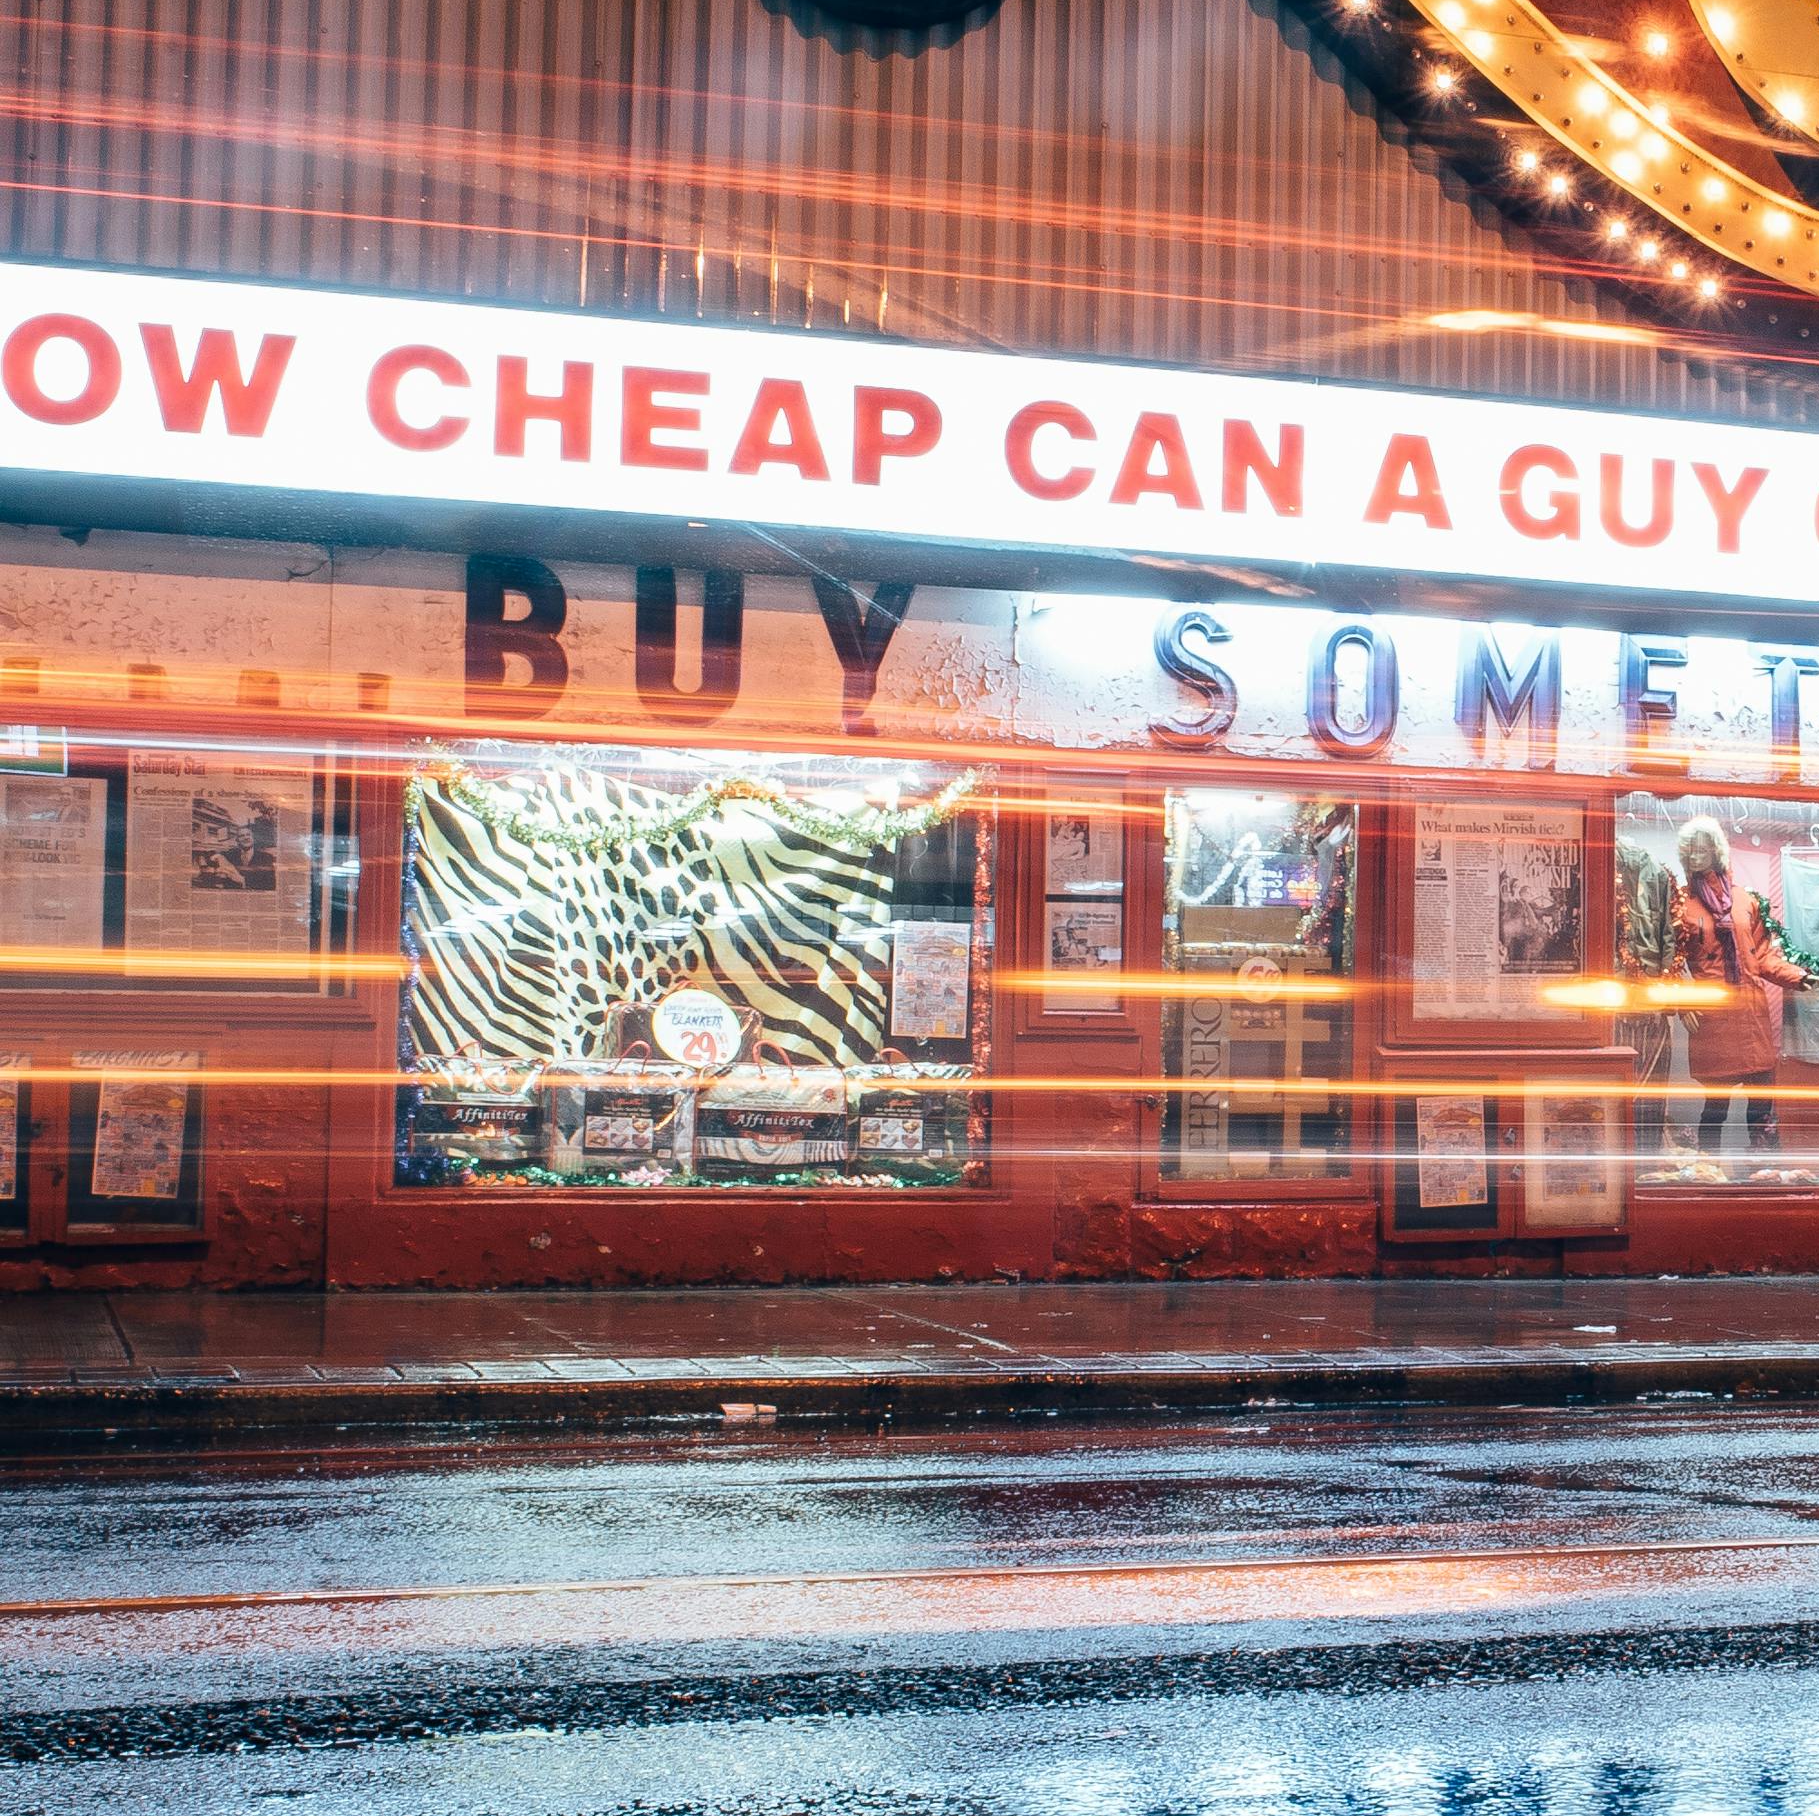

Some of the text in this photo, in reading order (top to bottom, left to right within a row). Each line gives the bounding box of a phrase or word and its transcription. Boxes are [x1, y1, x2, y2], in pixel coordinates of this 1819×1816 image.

[367, 344, 943, 485] CHEAP
[1004, 400, 1304, 517] CAN
[1364, 433, 1453, 530] A
[1498, 443, 1768, 553] GUY
[464, 554, 916, 739] BUY
[1421, 821, 1451, 833] What
[1456, 823, 1490, 834] makes
[1494, 823, 1536, 834] Mirvish
[1188, 996, 1223, 1151] FERRERO
